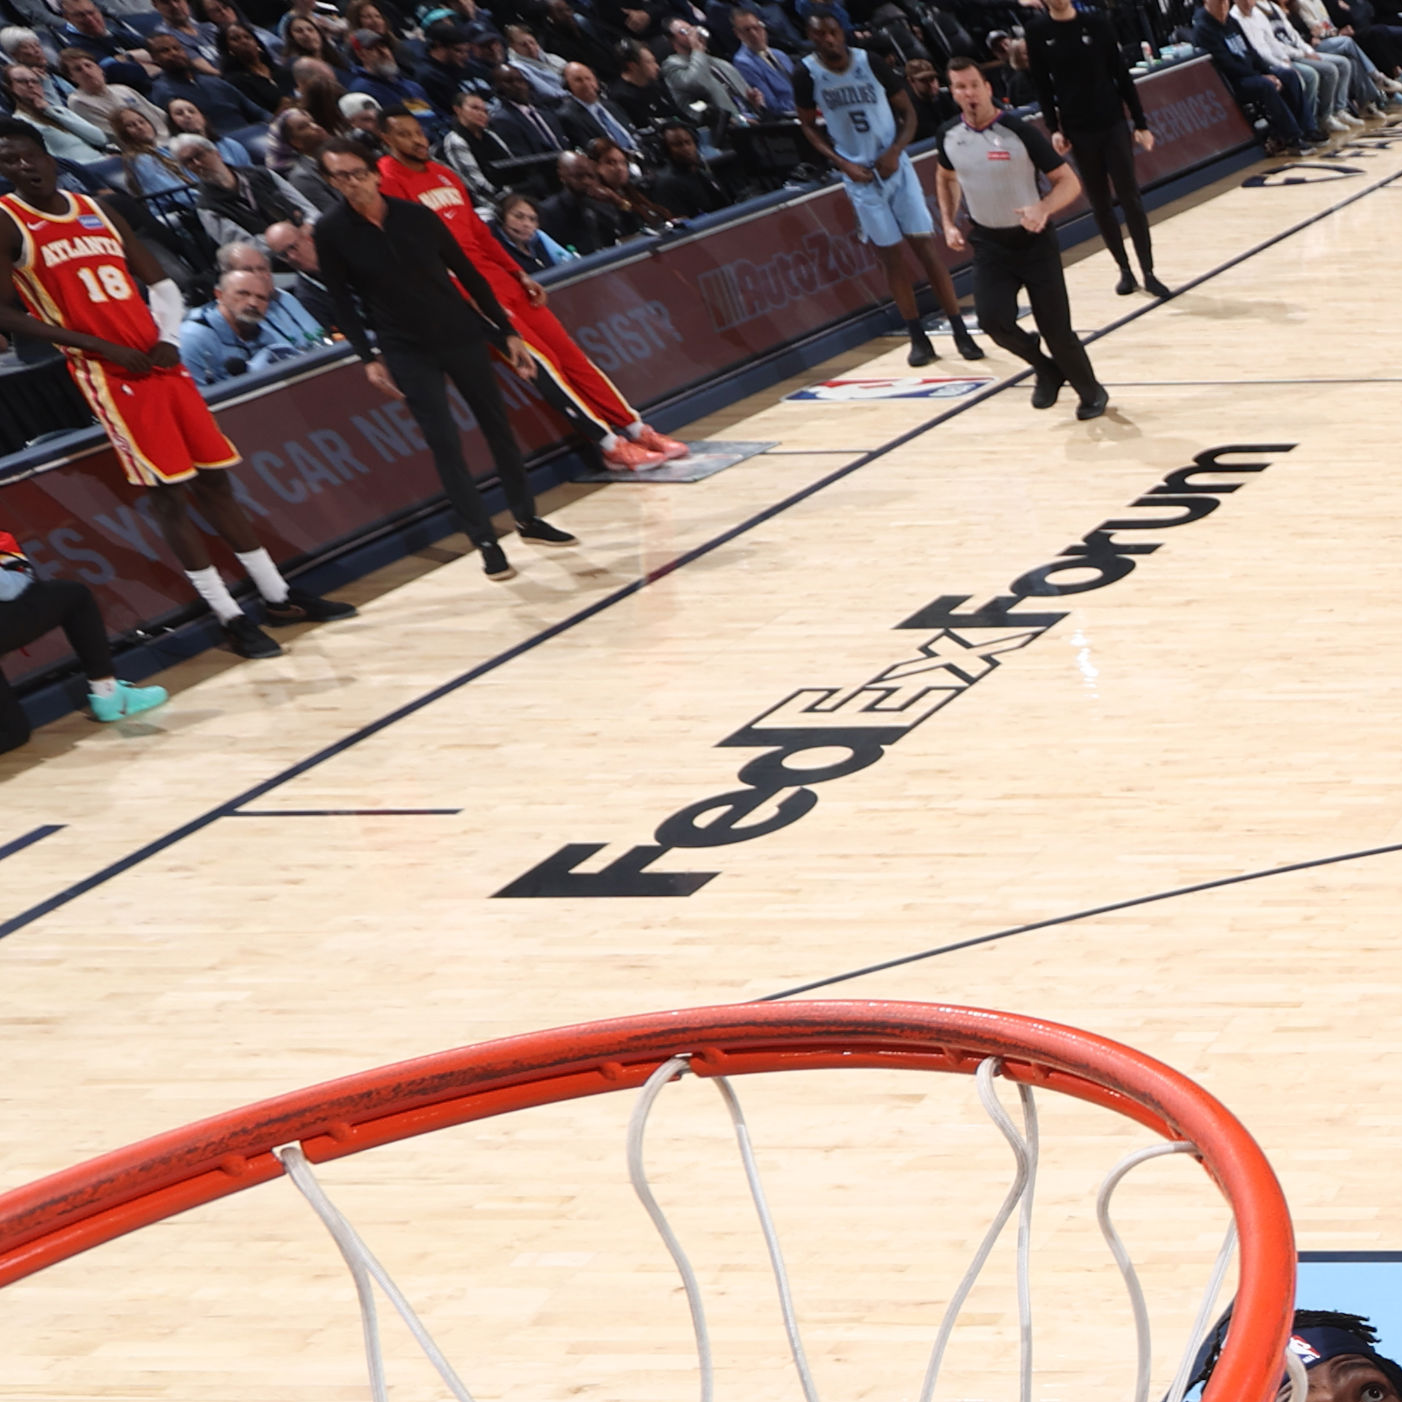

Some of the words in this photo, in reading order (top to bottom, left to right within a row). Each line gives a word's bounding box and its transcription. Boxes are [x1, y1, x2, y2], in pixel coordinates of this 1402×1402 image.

[849, 111, 870, 133] 5
[41, 235, 127, 268] ATLANTA
[77, 264, 132, 303] 18
[250, 428, 371, 503] CAR
